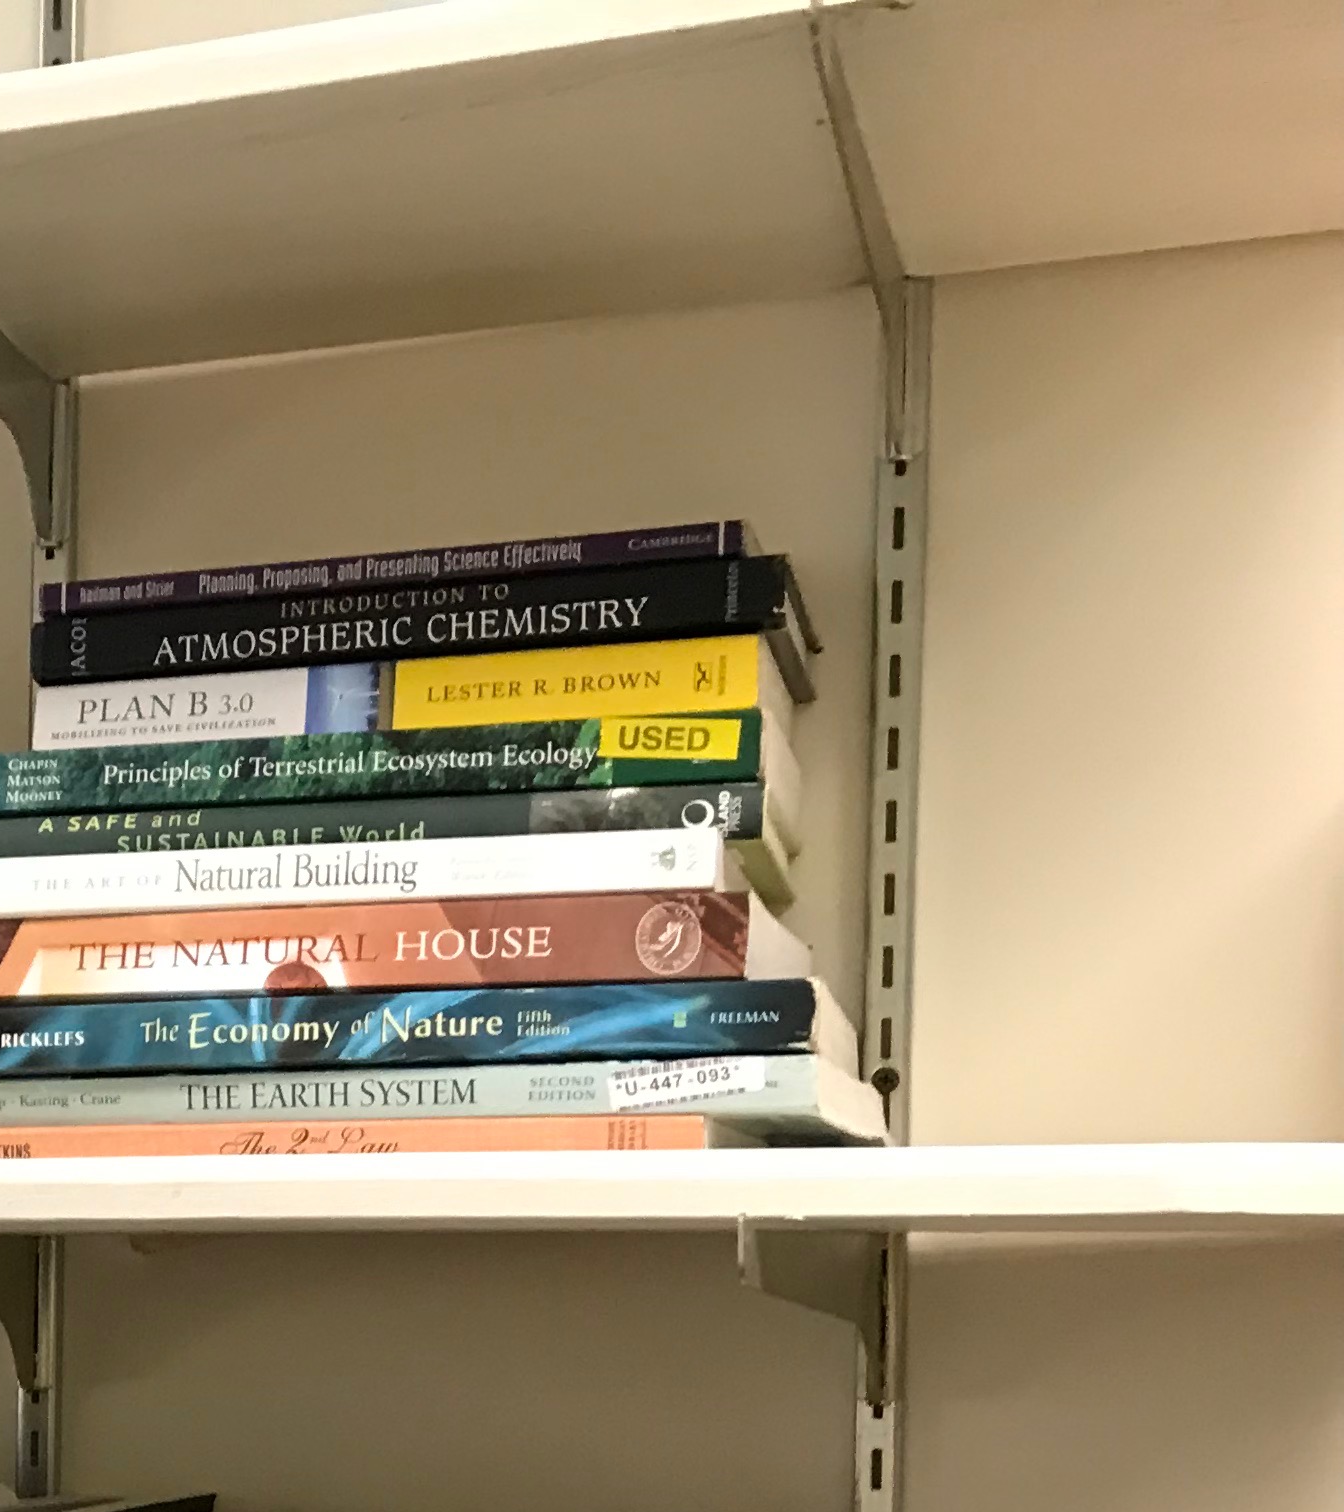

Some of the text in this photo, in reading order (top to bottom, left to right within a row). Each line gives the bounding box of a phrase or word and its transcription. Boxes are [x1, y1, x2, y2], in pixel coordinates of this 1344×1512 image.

[199, 572, 258, 595] Planning,
[263, 563, 332, 590] Proposing,
[337, 559, 362, 582] and
[366, 552, 439, 580] Presenting
[444, 548, 500, 570] Science
[504, 539, 582, 567] Effectively
[281, 584, 510, 618] INTRODUCTION TO
[153, 596, 649, 667] ATMOSPHERIC CHEMISTRY
[427, 680, 521, 704] LESTER
[563, 670, 662, 694] BROWN
[77, 690, 255, 725] PLAN B 3.0
[618, 725, 711, 752] USED
[7, 774, 61, 788] MATSON
[8, 757, 59, 772] CHAPIN
[104, 741, 598, 787] Principles of Terrestrial Ecosystem Ecology
[6, 789, 63, 804] MOONEY
[39, 810, 203, 833] A SAFE and
[339, 821, 424, 843] World
[174, 853, 283, 893] Natural
[294, 850, 418, 893] Building
[69, 926, 553, 971] THE NATURAL HOUSE
[0, 1030, 85, 1048] RICKLEFS
[140, 1007, 503, 1050] The Economy of Nature
[179, 1077, 477, 1111] THE EARTH SYSTEM
